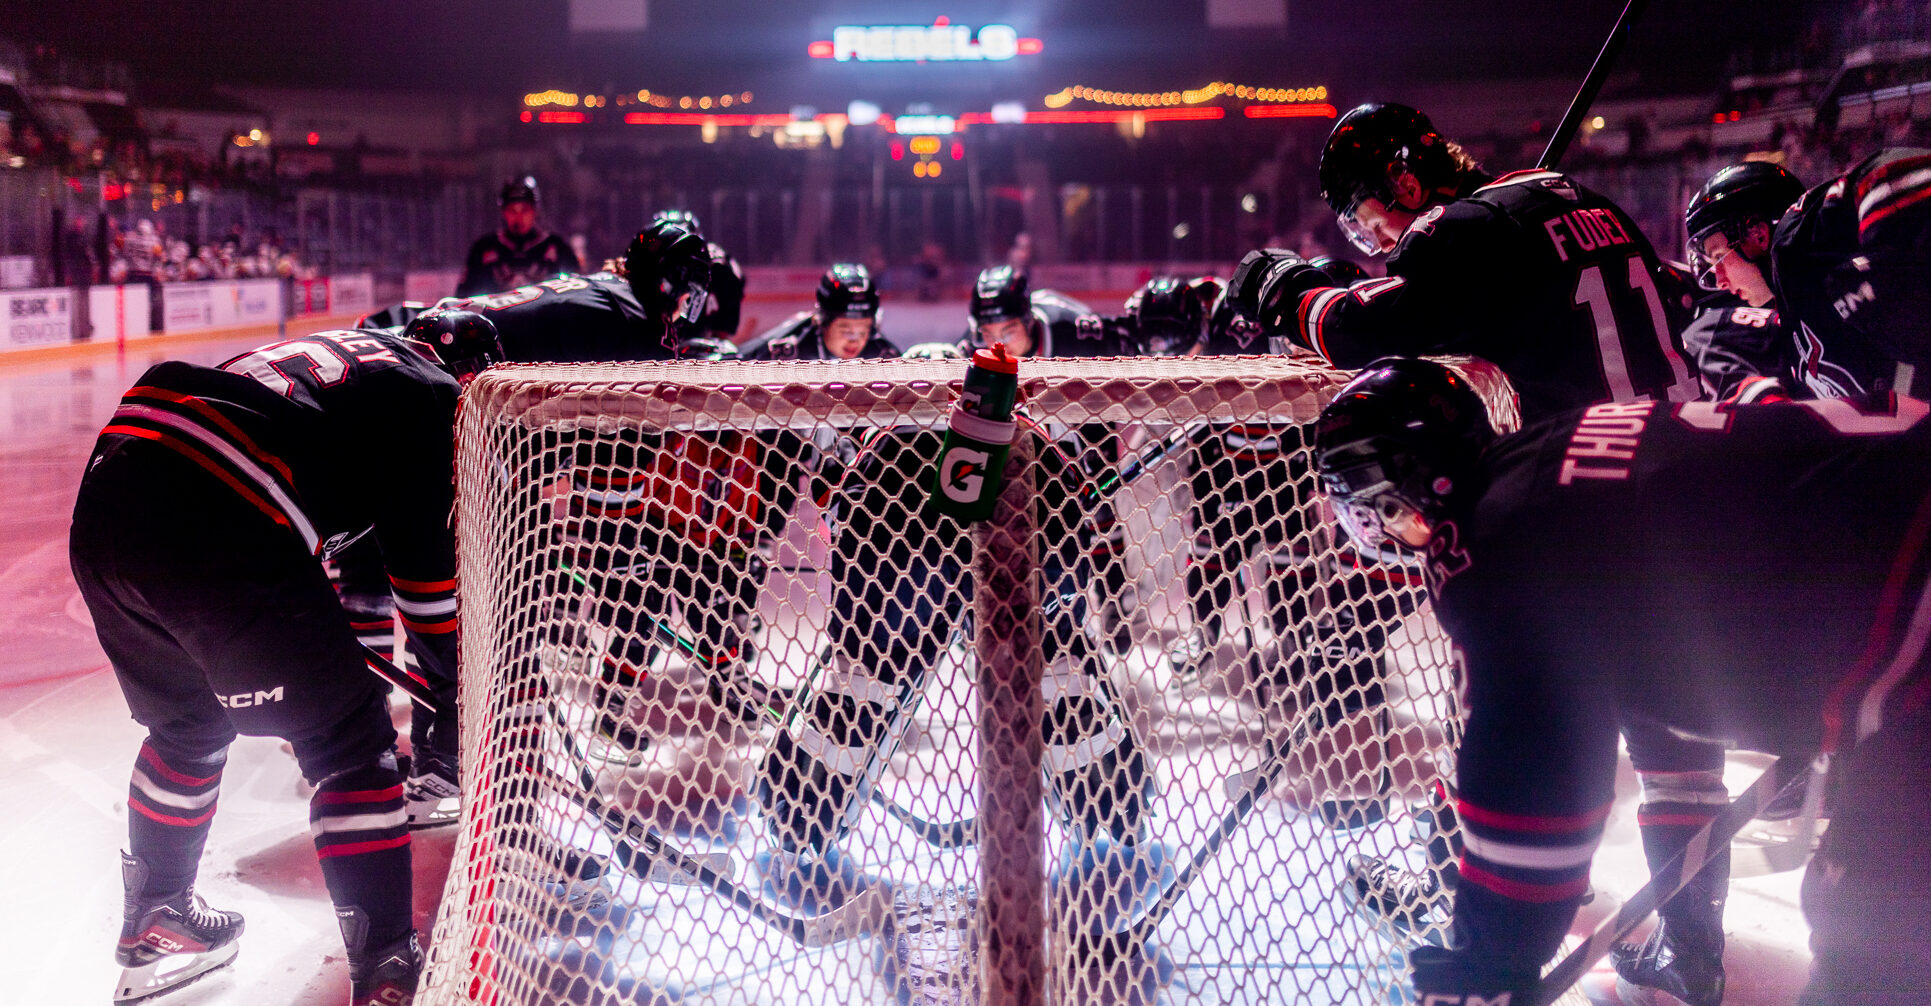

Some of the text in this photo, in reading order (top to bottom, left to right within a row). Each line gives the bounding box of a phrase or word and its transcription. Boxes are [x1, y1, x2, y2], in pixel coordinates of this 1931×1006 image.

[1572, 252, 1701, 403] 11
[940, 447, 989, 504] G
[145, 932, 184, 952] CCM
